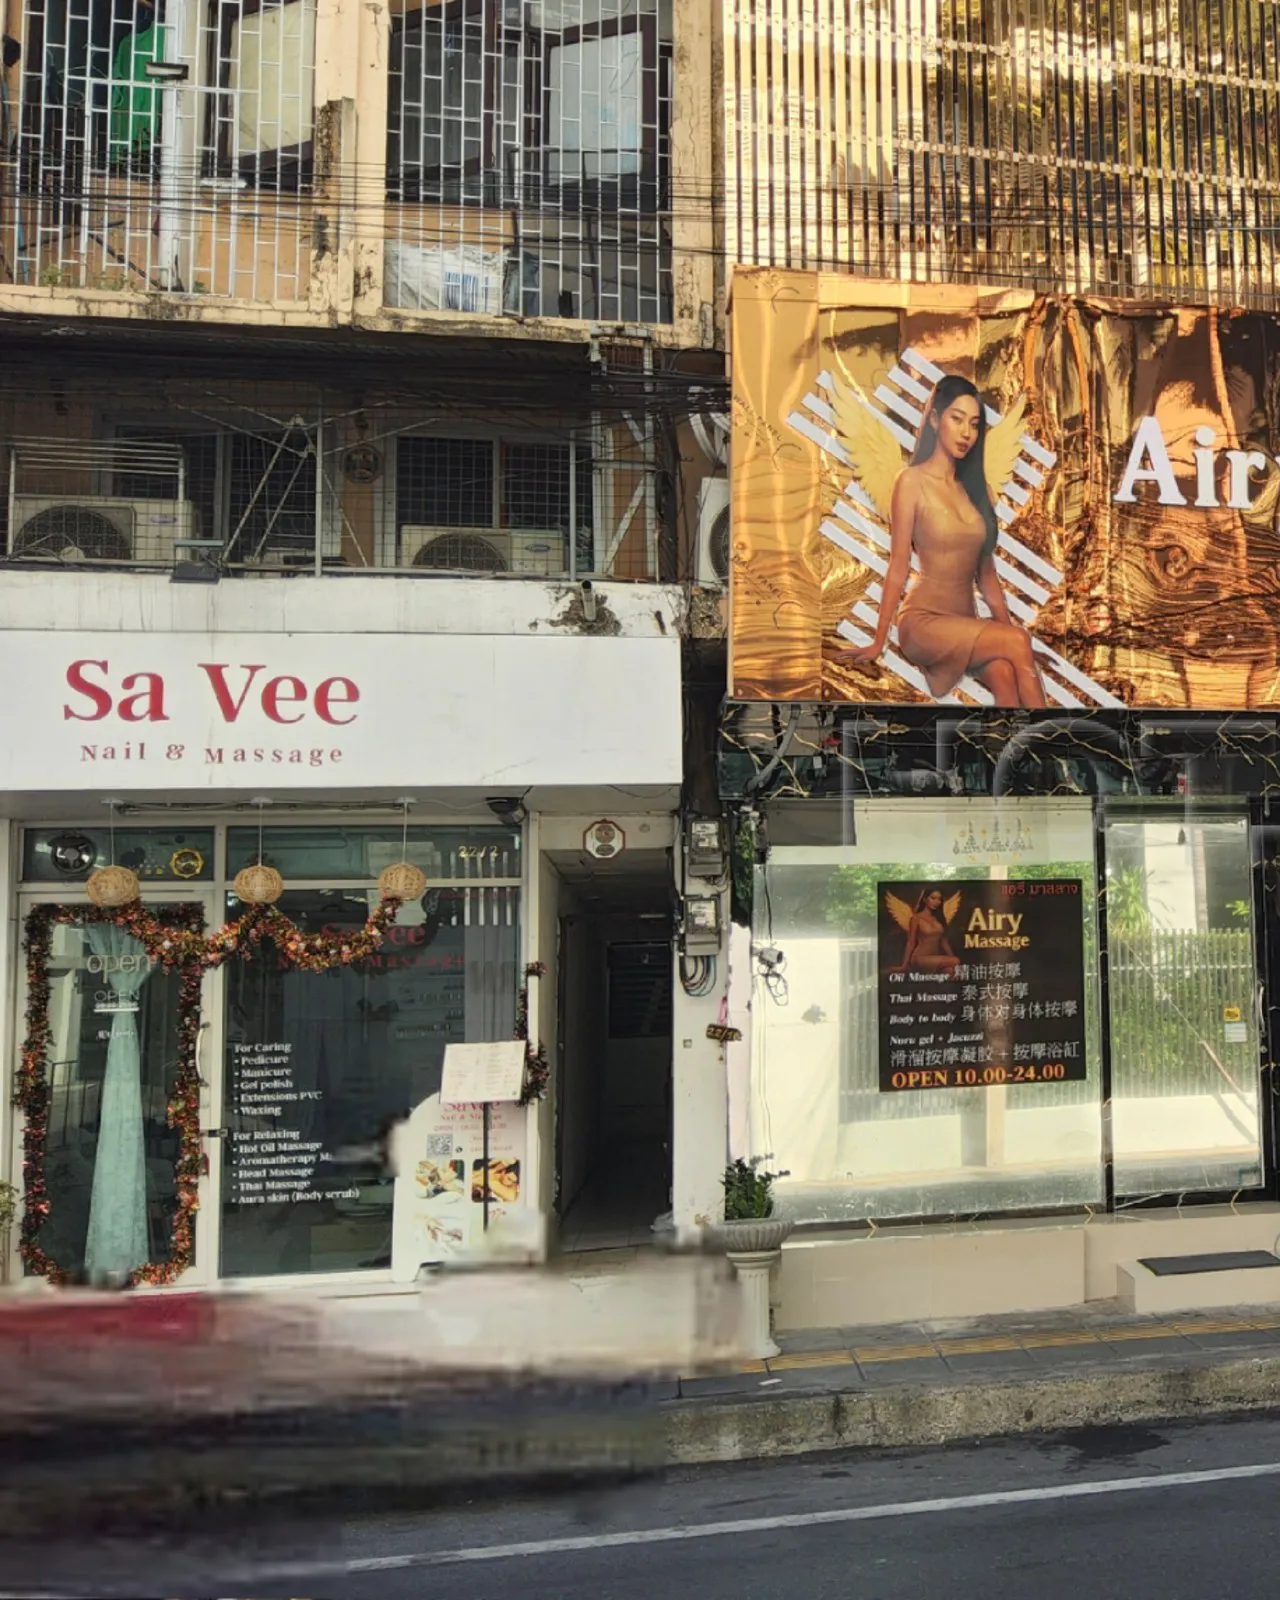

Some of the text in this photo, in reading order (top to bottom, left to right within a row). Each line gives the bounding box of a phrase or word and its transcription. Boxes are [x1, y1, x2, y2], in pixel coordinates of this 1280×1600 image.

[64, 660, 360, 725] Sa Vee
[80, 742, 343, 767] Nail & Massage
[458, 845, 499, 858] 22/2
[968, 908, 1023, 935] Airy
[964, 934, 1030, 951] Massage
[87, 955, 150, 984] open
[954, 962, 1022, 981] 精油按摩
[889, 972, 950, 983] Oil Massage
[95, 990, 140, 1003] OPEN
[889, 992, 958, 1004] Thai Massage
[962, 982, 1029, 1001] 泰式按摩
[961, 1000, 1078, 1022] 身体对身体按摩
[889, 1012, 956, 1026] Body to body
[918, 1034, 935, 1047] gel
[235, 1042, 292, 1053] For Caring
[1013, 1041, 1080, 1061] 按摩浴缸
[241, 1055, 289, 1066] Pedicure
[241, 1068, 292, 1078] Manicure
[891, 1064, 1066, 1088] OPEN 10.00-24.00
[240, 1079, 293, 1091] Gel polish
[241, 1091, 323, 1103] Extensions PVC
[240, 1105, 282, 1116] Waxing
[233, 1130, 300, 1141] For Relaxing
[240, 1142, 322, 1154] Hot Oil Massage
[240, 1154, 317, 1165] Aromatherapy
[239, 1167, 314, 1179] Head Massage
[240, 1180, 311, 1192] Thai Massage
[239, 1188, 360, 1204] Aura skin (Body scrub)
